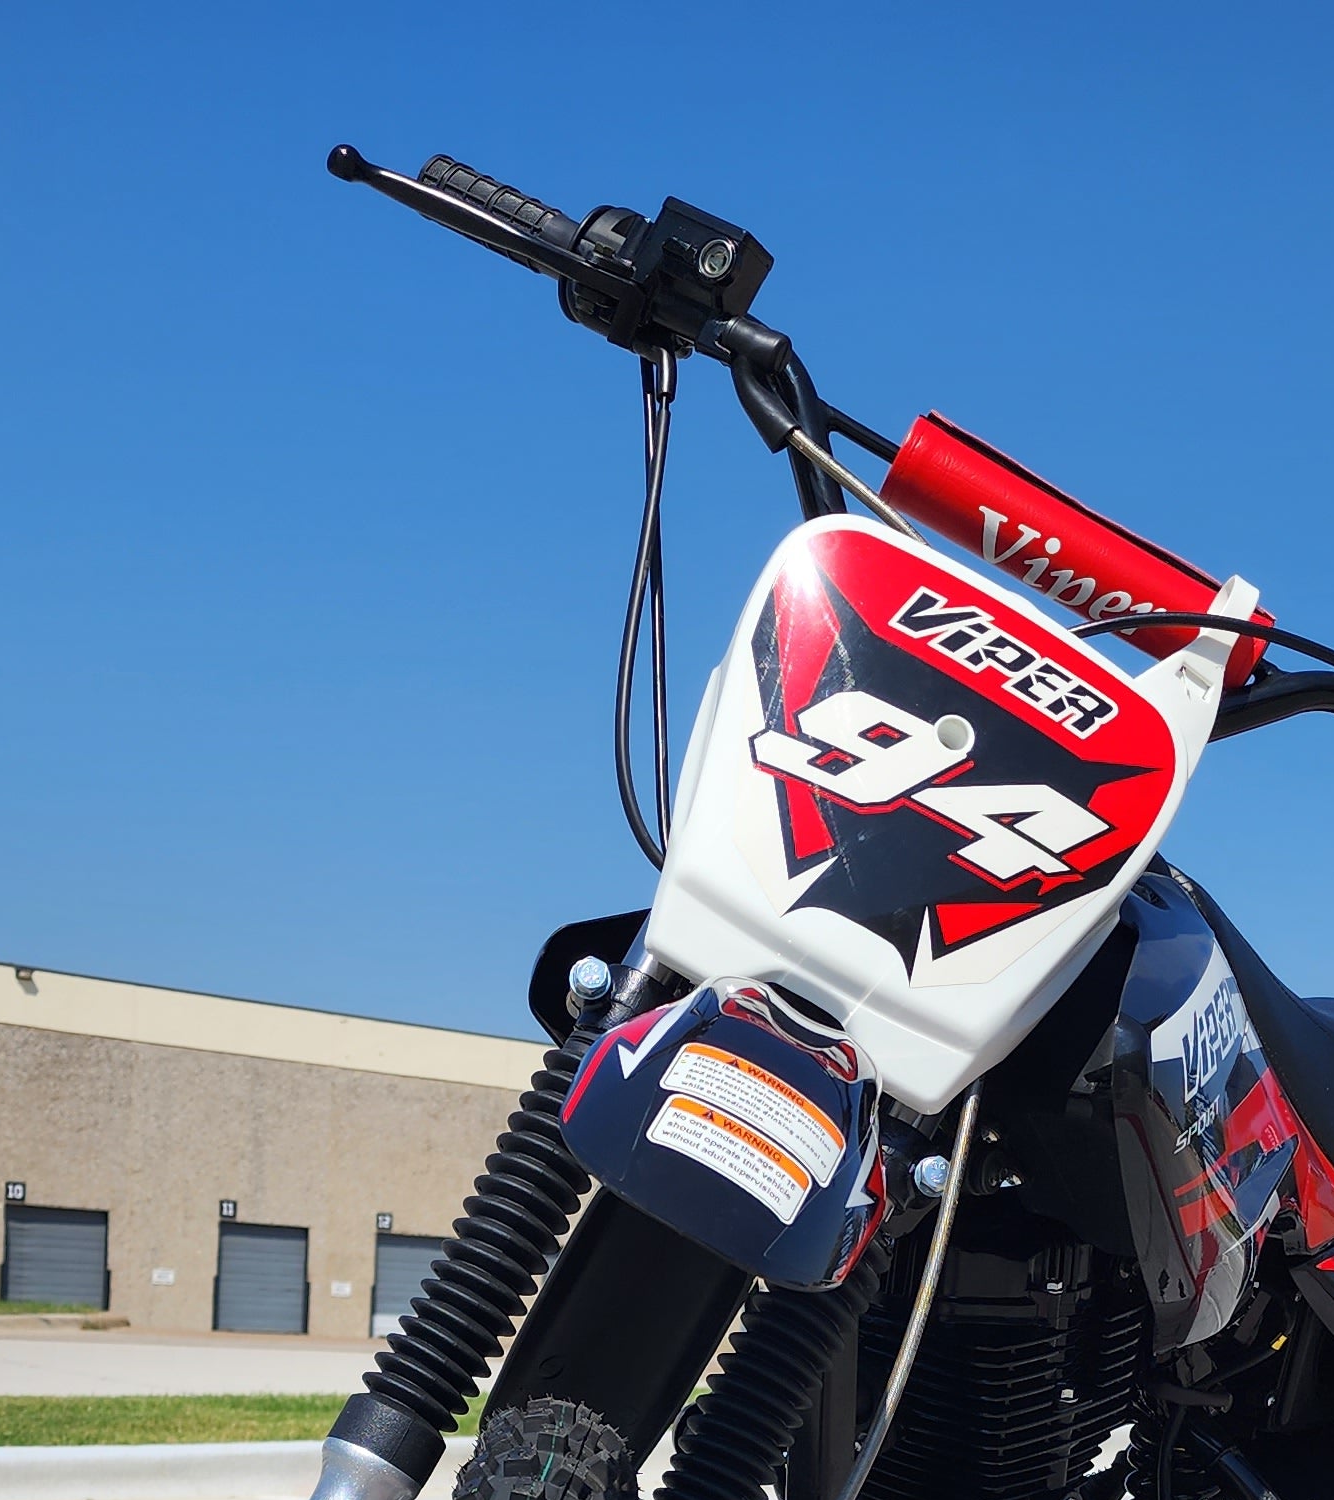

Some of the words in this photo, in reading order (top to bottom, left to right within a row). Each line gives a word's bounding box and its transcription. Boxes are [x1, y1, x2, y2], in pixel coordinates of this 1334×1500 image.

[753, 690, 1110, 880] 94
[748, 1065, 804, 1107] WARNING
[673, 1111, 687, 1121] No
[689, 1119, 708, 1131] one
[710, 1129, 740, 1148] under
[740, 1144, 755, 1158] the
[757, 1157, 774, 1172] age
[775, 1169, 786, 1181] of
[723, 1119, 783, 1162] WARNING
[1173, 1095, 1220, 1155] SPORT
[661, 1129, 700, 1150] without
[701, 1146, 728, 1164] adult
[727, 1161, 782, 1206] supervision.
[666, 1120, 703, 1139] should
[703, 1136, 741, 1159] operate
[742, 1156, 760, 1173] this
[762, 1171, 792, 1200] vehicle
[7, 1184, 23, 1199] 10
[222, 1202, 234, 1216] 11
